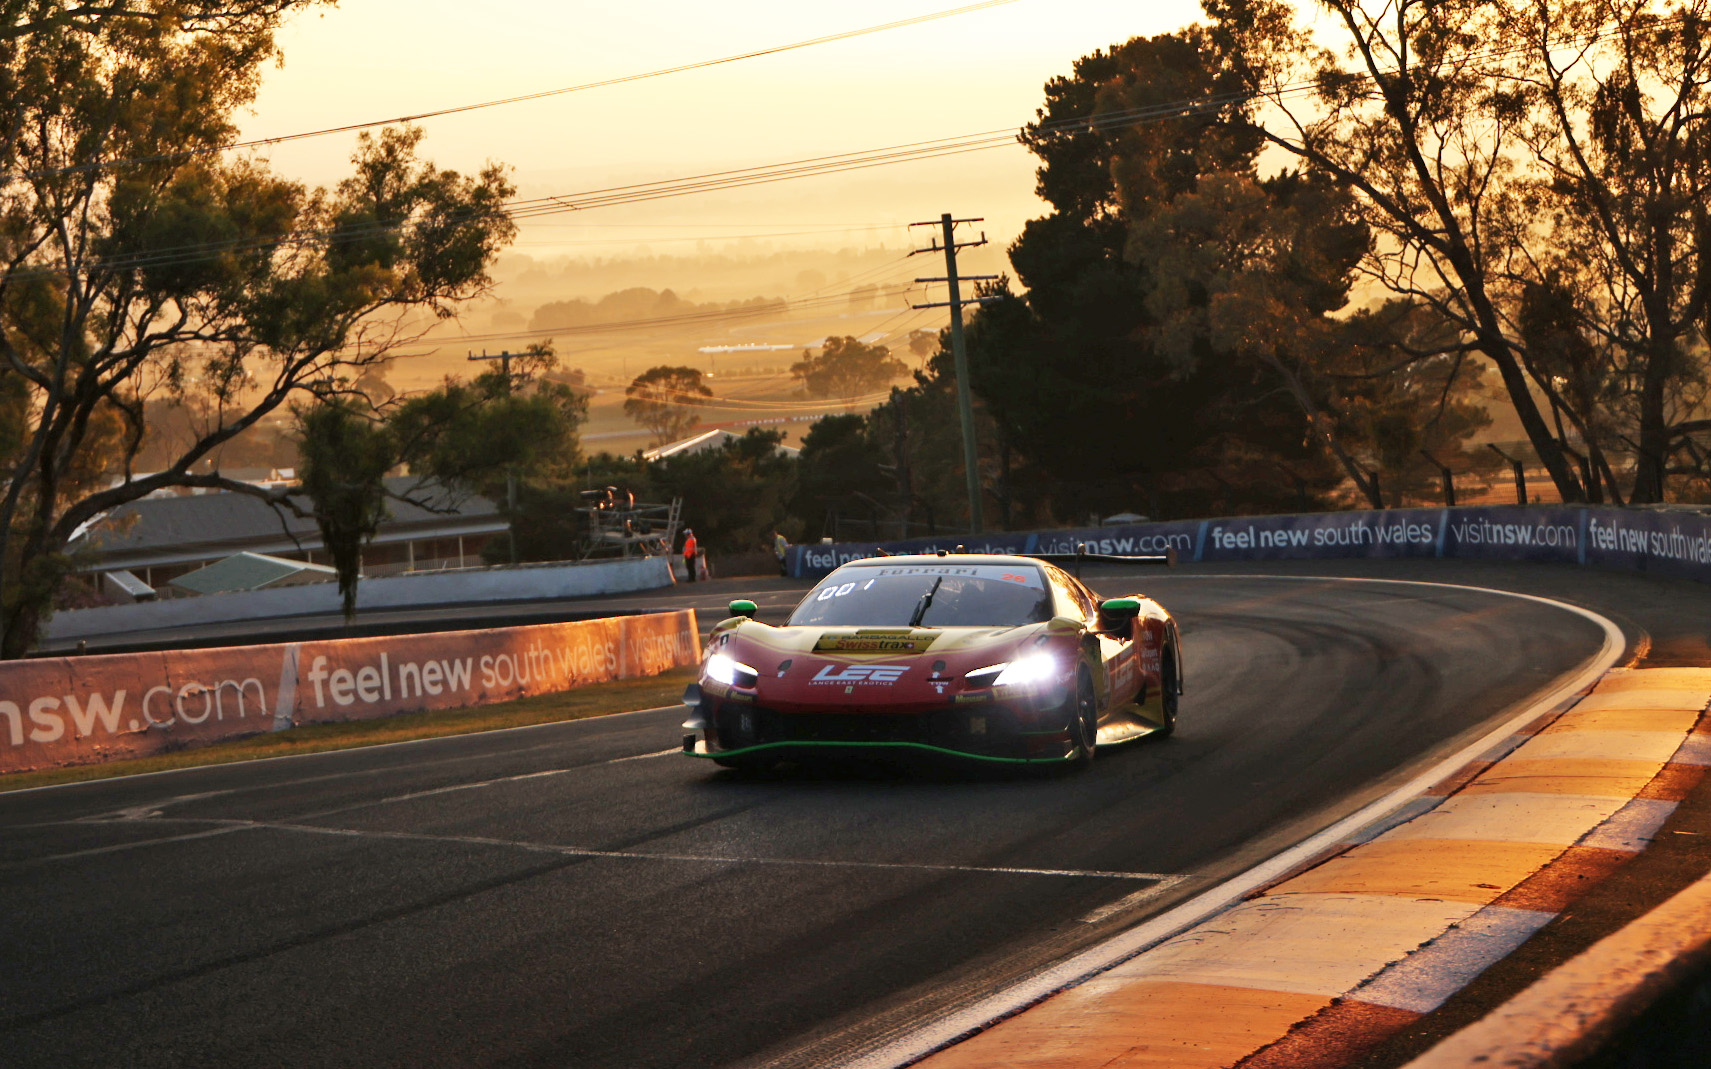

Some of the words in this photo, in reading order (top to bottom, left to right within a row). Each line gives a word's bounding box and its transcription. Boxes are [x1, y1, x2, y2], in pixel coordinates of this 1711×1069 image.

[1212, 525, 1255, 549] feel
[1260, 529, 1309, 548] new
[1313, 520, 1372, 546] south
[1375, 518, 1433, 544] wales
[1451, 517, 1576, 547] visitnsw.com
[1589, 517, 1619, 550] feel
[1619, 528, 1648, 554] new
[1651, 525, 1687, 559] south
[1687, 528, 1711, 564] wal
[805, 549, 837, 568] feel
[878, 568, 979, 577] Ferrari
[1002, 573, 1026, 583] 26
[817, 578, 876, 602] 001
[836, 639, 909, 650] Swisstrax
[308, 652, 392, 708] feel
[399, 656, 473, 699] new
[480, 638, 555, 689] south
[556, 634, 617, 678] wales
[811, 665, 911, 681] LEE
